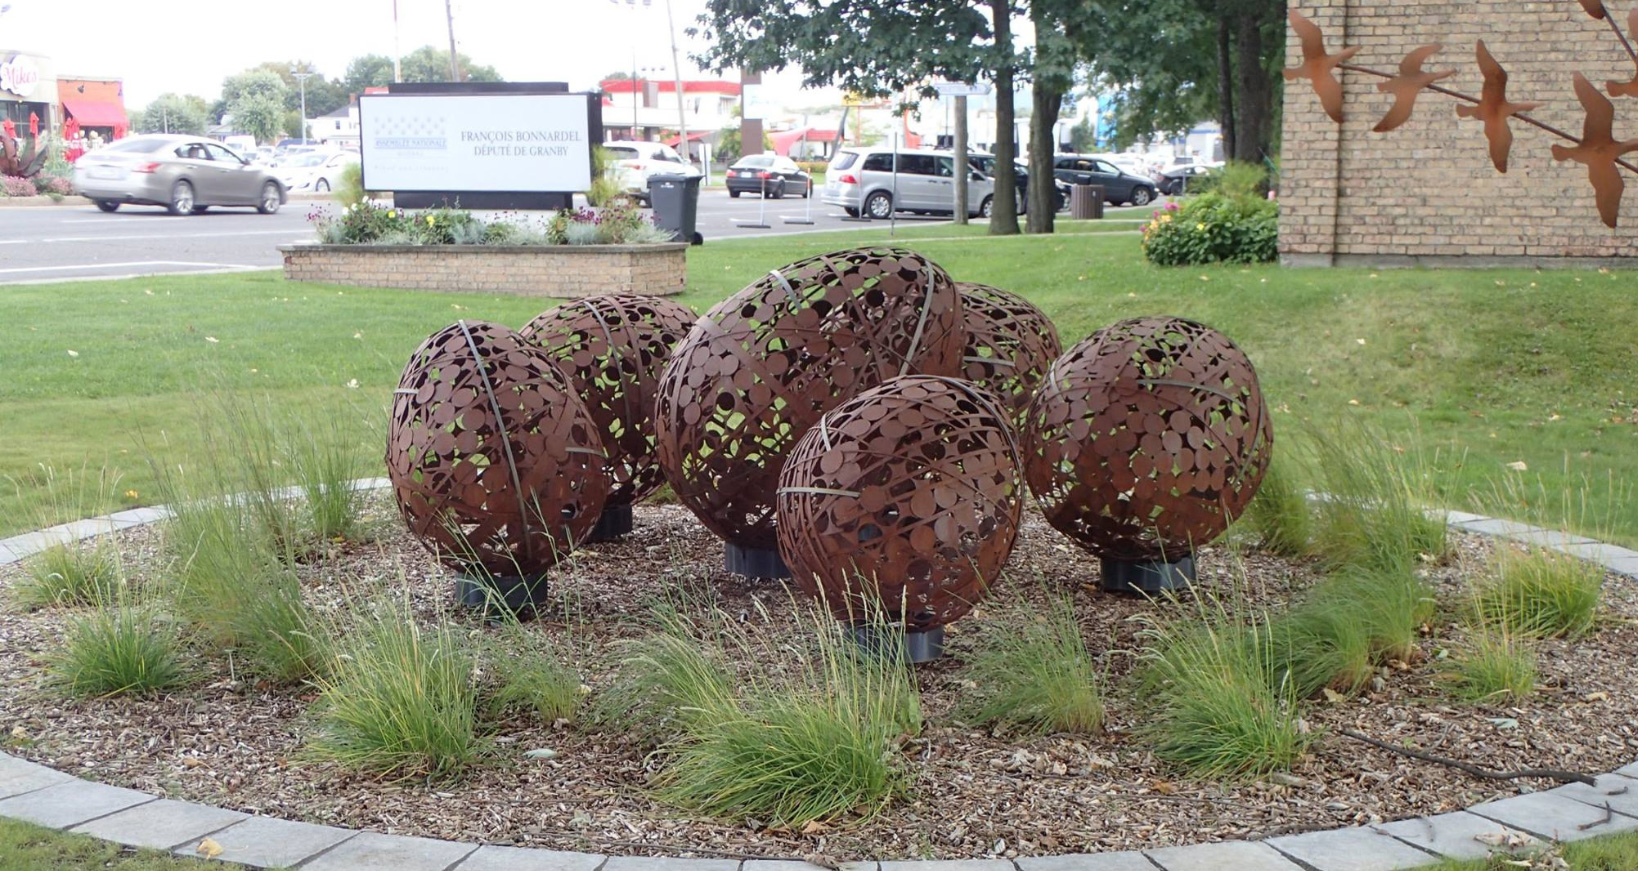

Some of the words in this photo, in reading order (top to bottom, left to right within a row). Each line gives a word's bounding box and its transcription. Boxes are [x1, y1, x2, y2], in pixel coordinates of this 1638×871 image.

[4, 66, 37, 89] Mikes
[461, 131, 514, 144] FRANÇOIS
[516, 131, 581, 142] BONNARDEL
[474, 144, 511, 156] DÉPUTÉ
[514, 146, 527, 156] DE
[529, 146, 569, 156] GRANBY
